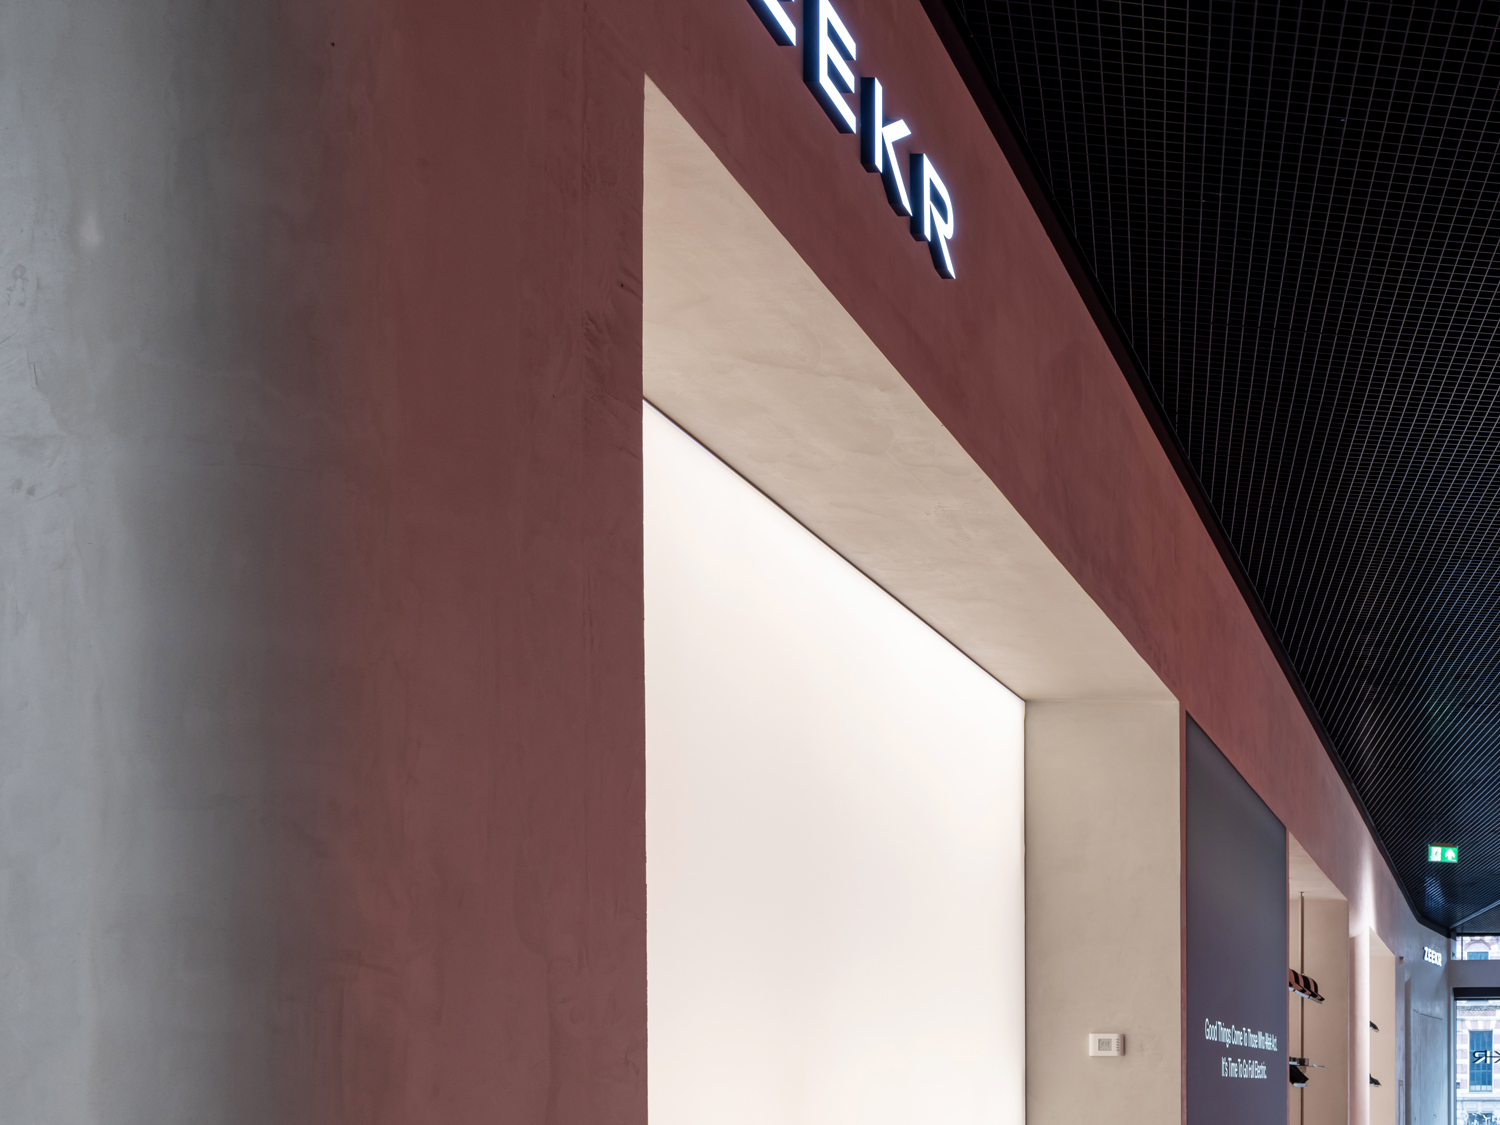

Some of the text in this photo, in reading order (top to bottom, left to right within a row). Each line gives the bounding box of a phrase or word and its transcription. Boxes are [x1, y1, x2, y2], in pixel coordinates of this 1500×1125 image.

[1422, 946, 1442, 966] ZEEKR
[1204, 1018, 1218, 1042] Good
[1218, 1022, 1232, 1048] Things
[1232, 1024, 1242, 1046] Come
[1242, 1028, 1248, 1046] To
[1228, 1058, 1238, 1078] Time
[1238, 1058, 1242, 1078] To
[1242, 1058, 1248, 1078] Go
